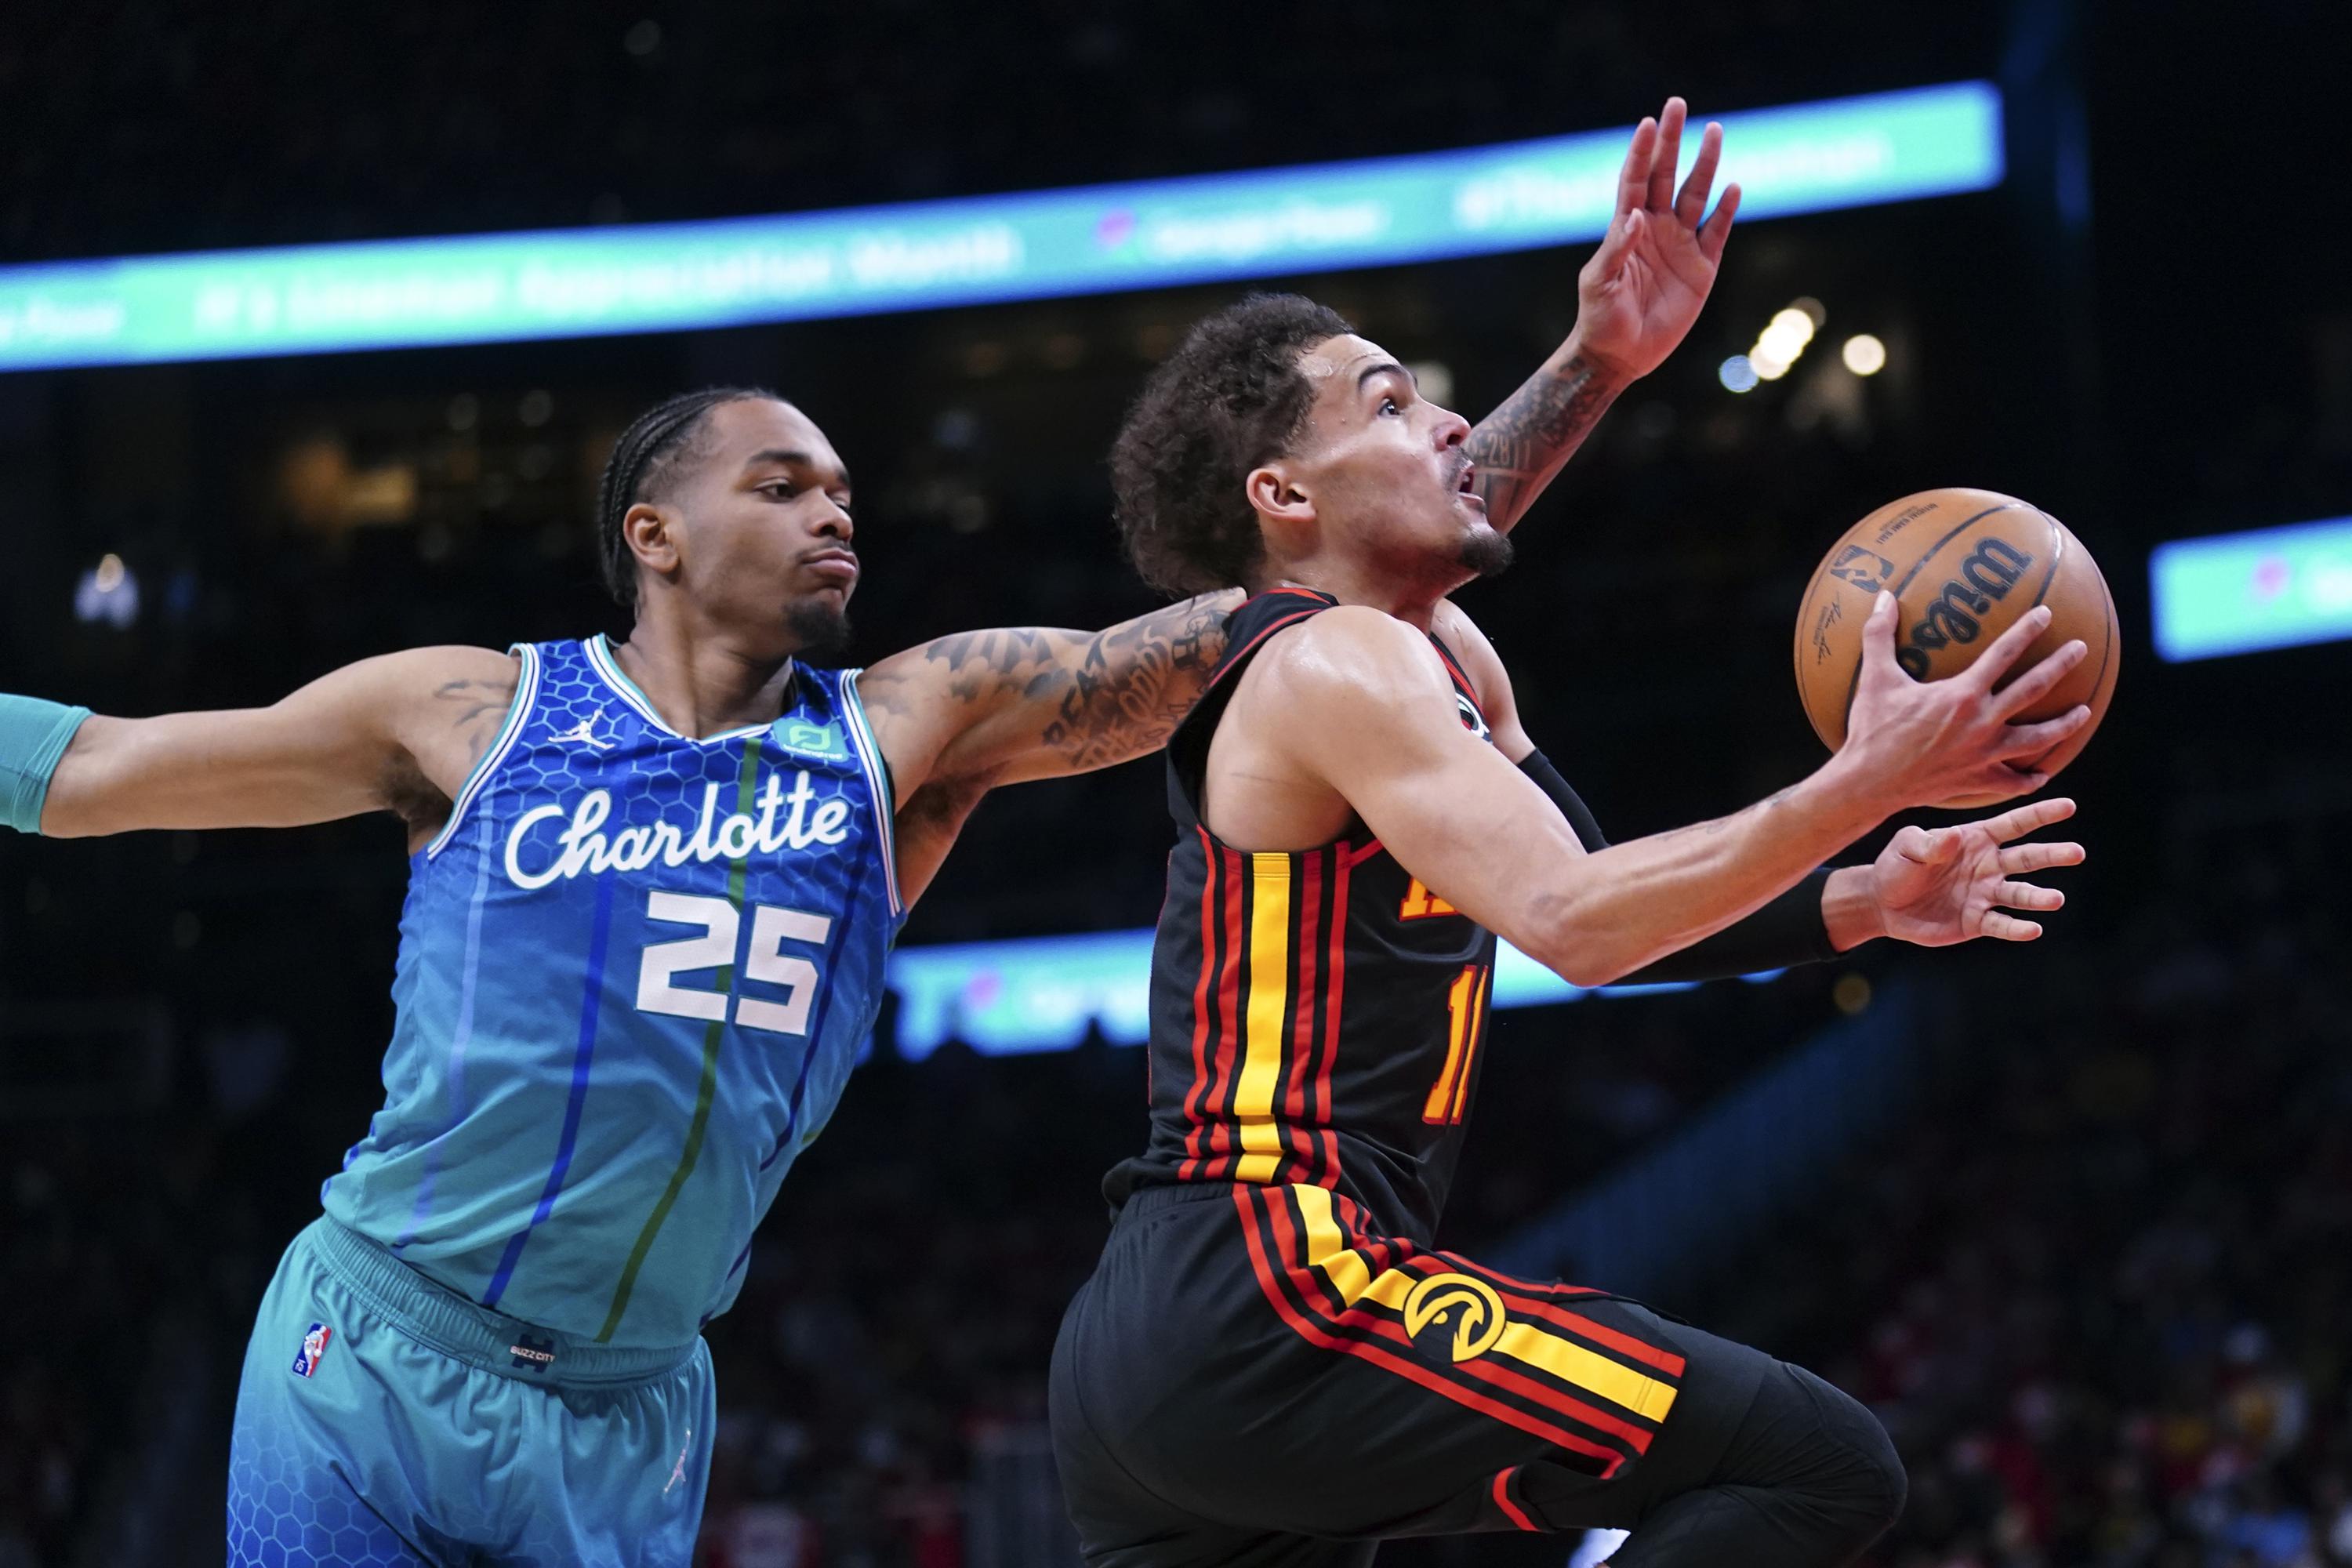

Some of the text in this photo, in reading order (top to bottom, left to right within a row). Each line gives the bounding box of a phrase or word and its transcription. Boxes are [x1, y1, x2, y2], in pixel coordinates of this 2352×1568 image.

[1897, 538, 2034, 681] Wilso
[504, 770, 851, 890] Charlotte
[635, 890, 833, 1036] 25
[1421, 964, 1489, 1125] 11
[510, 1345, 556, 1363] BUZZ CITY
